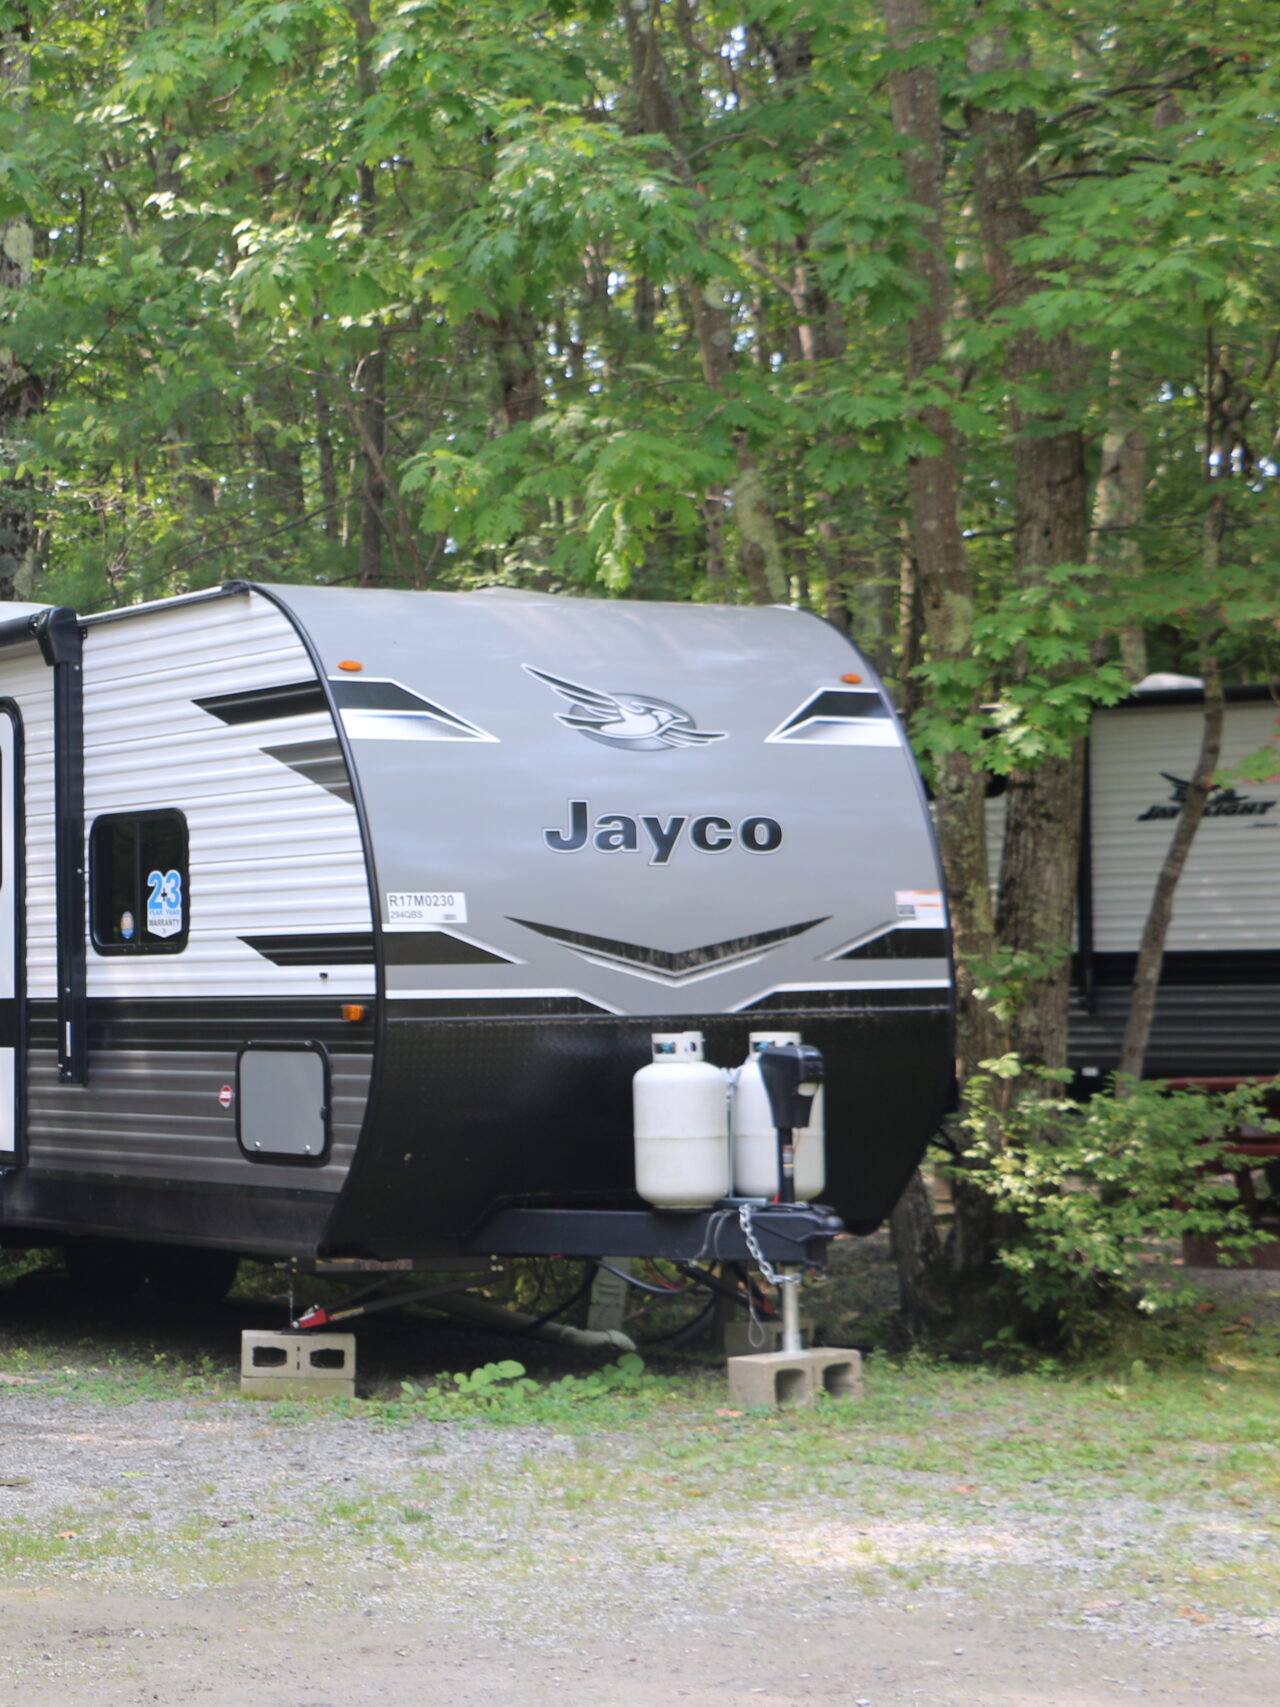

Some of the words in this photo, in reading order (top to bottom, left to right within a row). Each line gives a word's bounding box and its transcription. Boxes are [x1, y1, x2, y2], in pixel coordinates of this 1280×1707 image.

[1192, 801, 1277, 816] LIGHT
[542, 799, 783, 866] Jayco
[388, 895, 455, 907] R17M0230
[390, 910, 424, 919] 294QBS
[149, 919, 180, 927] WARRANTY
